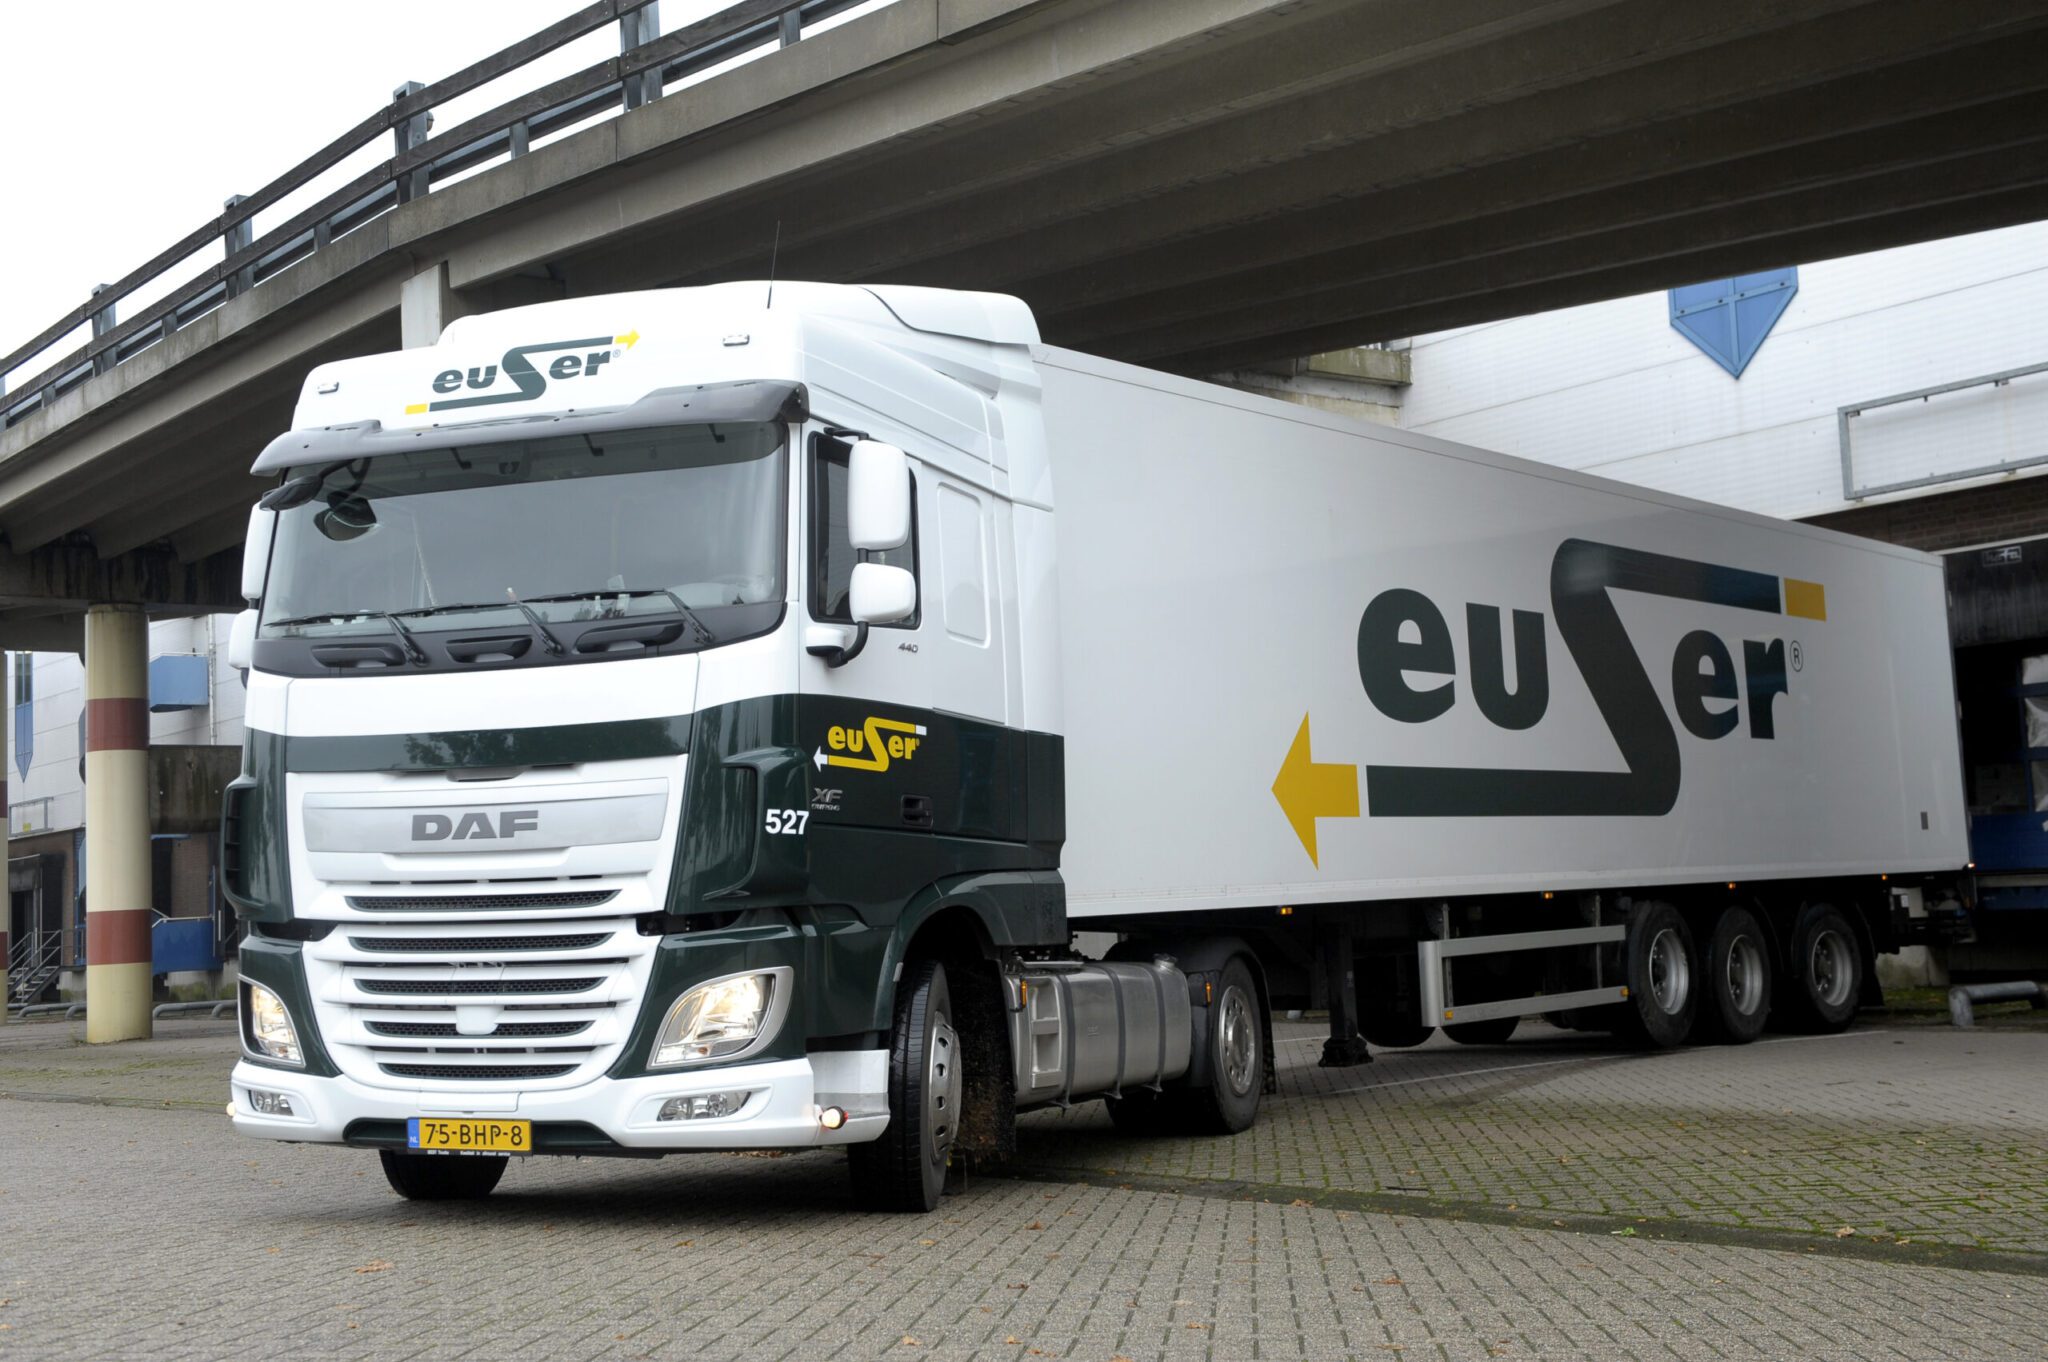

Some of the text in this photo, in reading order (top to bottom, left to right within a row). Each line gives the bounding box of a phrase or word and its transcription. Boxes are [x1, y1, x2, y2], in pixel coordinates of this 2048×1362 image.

[898, 642, 919, 654] 440
[811, 787, 843, 803] XF
[411, 810, 539, 842] DAF
[764, 808, 810, 836] 527
[424, 1123, 523, 1147] 75-BHP-8
